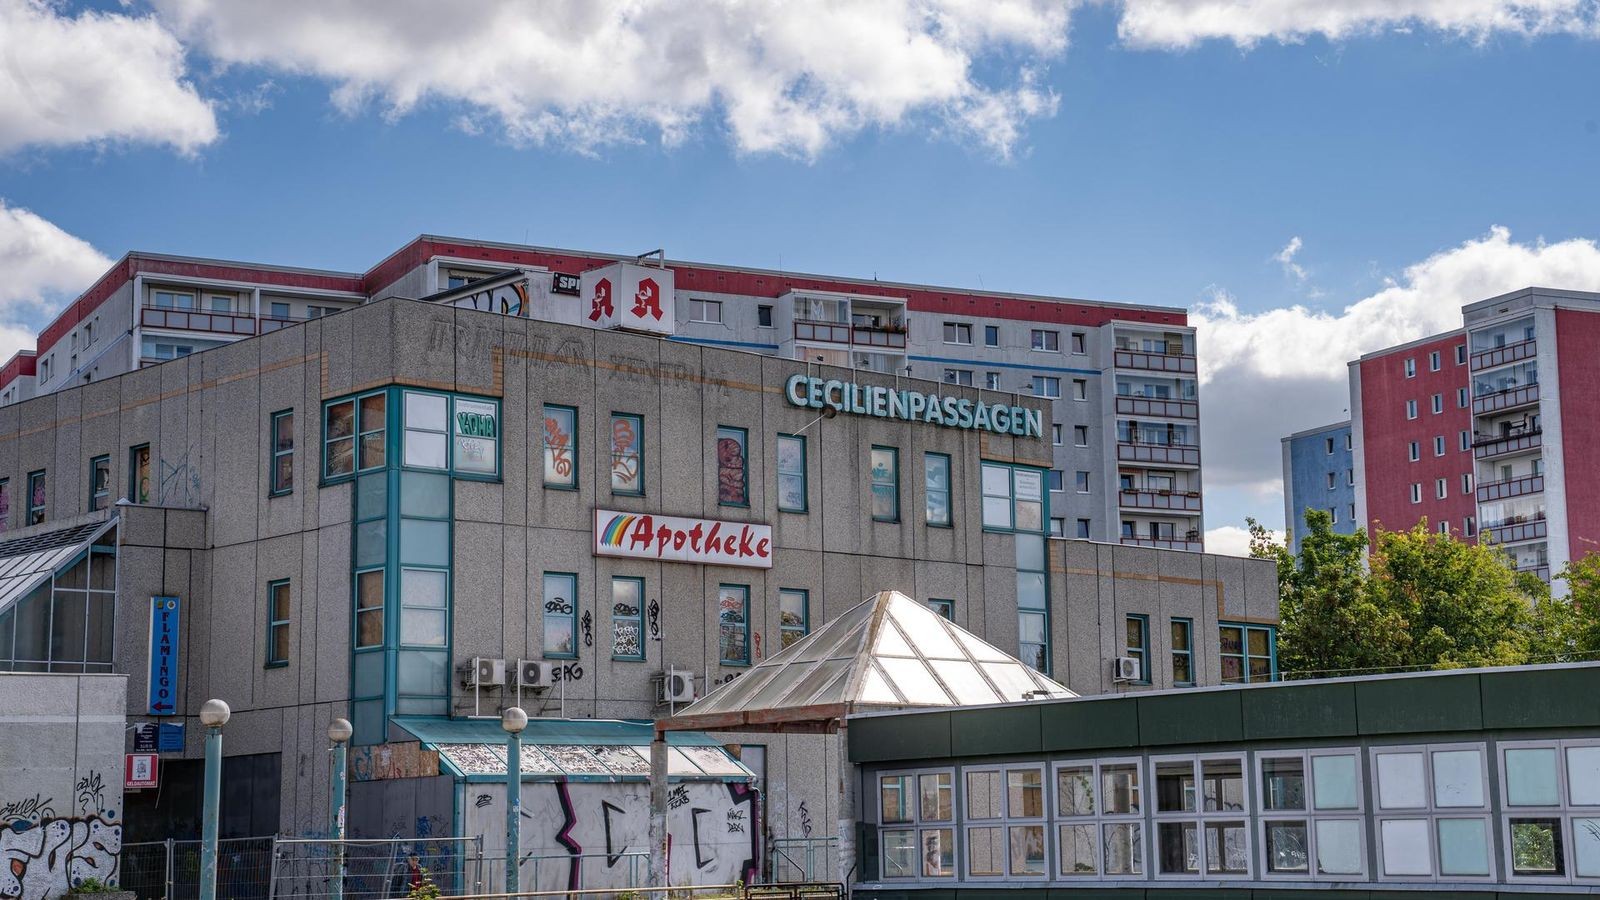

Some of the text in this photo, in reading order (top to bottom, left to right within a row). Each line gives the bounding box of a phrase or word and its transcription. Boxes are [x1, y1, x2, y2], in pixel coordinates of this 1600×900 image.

[630, 277, 664, 322] A
[785, 374, 1043, 438] CECILIENPASSAGEN
[629, 515, 770, 558] Apotheke
[158, 611, 171, 699] FLAMINGO
